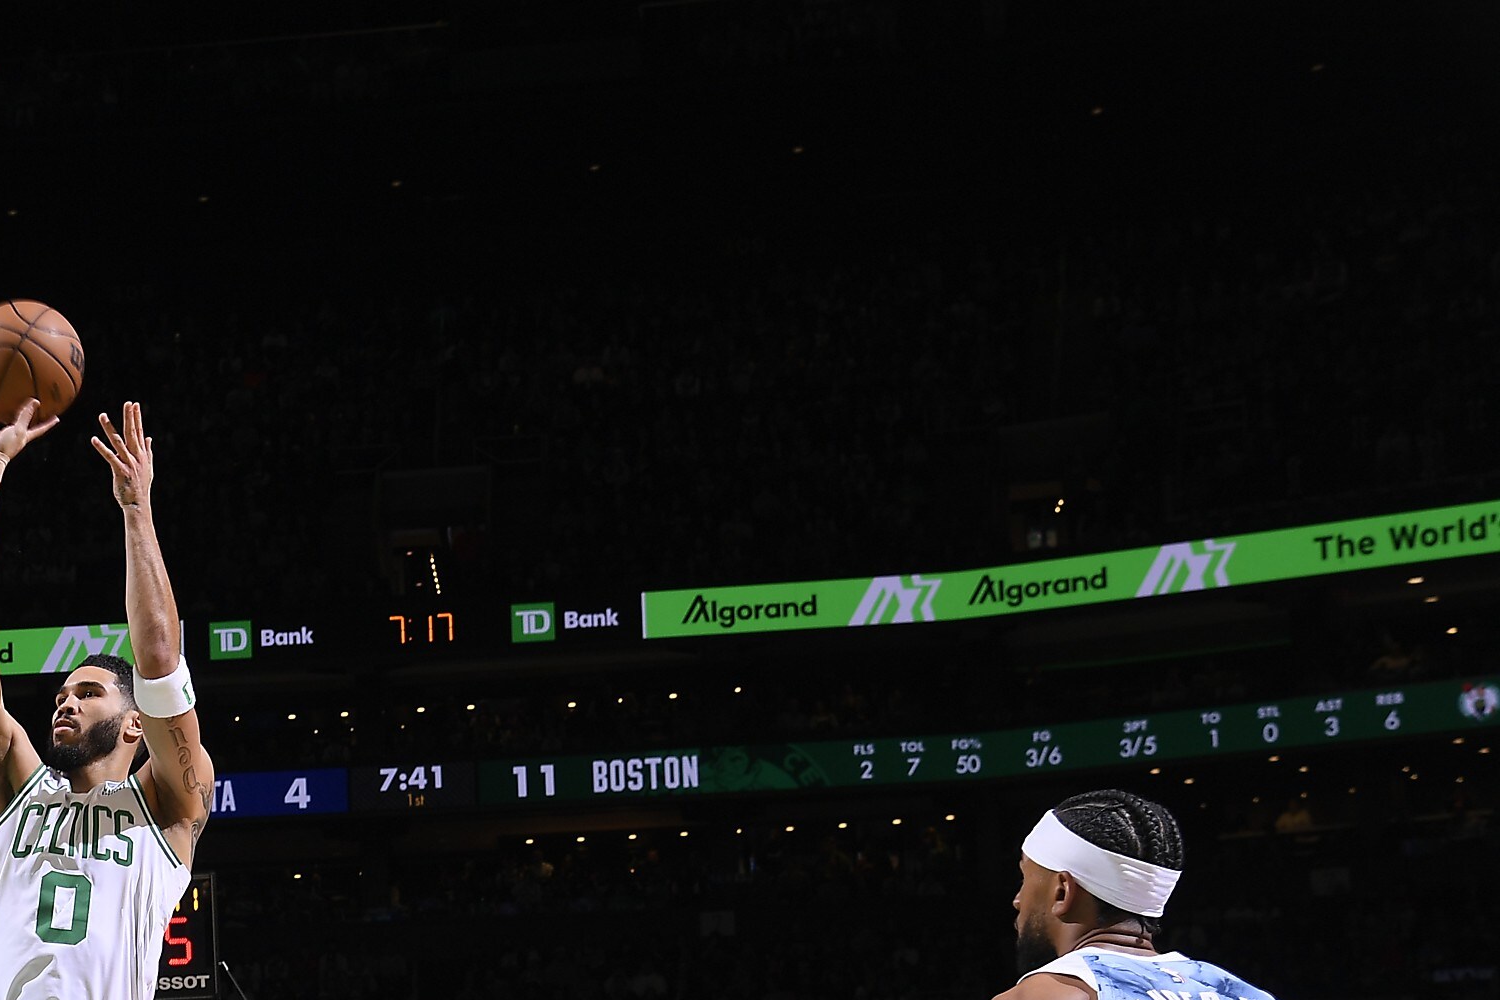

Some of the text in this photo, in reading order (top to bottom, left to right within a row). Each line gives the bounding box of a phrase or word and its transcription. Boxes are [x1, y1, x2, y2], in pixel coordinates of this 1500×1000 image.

[1313, 512, 1500, 561] The World'
[968, 566, 1108, 607] Algorand
[389, 612, 454, 644] 7:17
[564, 607, 619, 630] Bank
[682, 594, 818, 629] Algorand
[260, 626, 314, 647] Bank
[860, 709, 1401, 780] 2 7 50 3/6 3/5 1 0 3 6
[379, 765, 443, 792] 7:41
[512, 764, 556, 798] 11
[592, 755, 699, 793] BOSTON
[284, 777, 311, 809] 4
[407, 793, 425, 807] 1st
[11, 801, 135, 868] CELTICS
[34, 869, 93, 946] 0
[155, 974, 210, 991] SSOT
